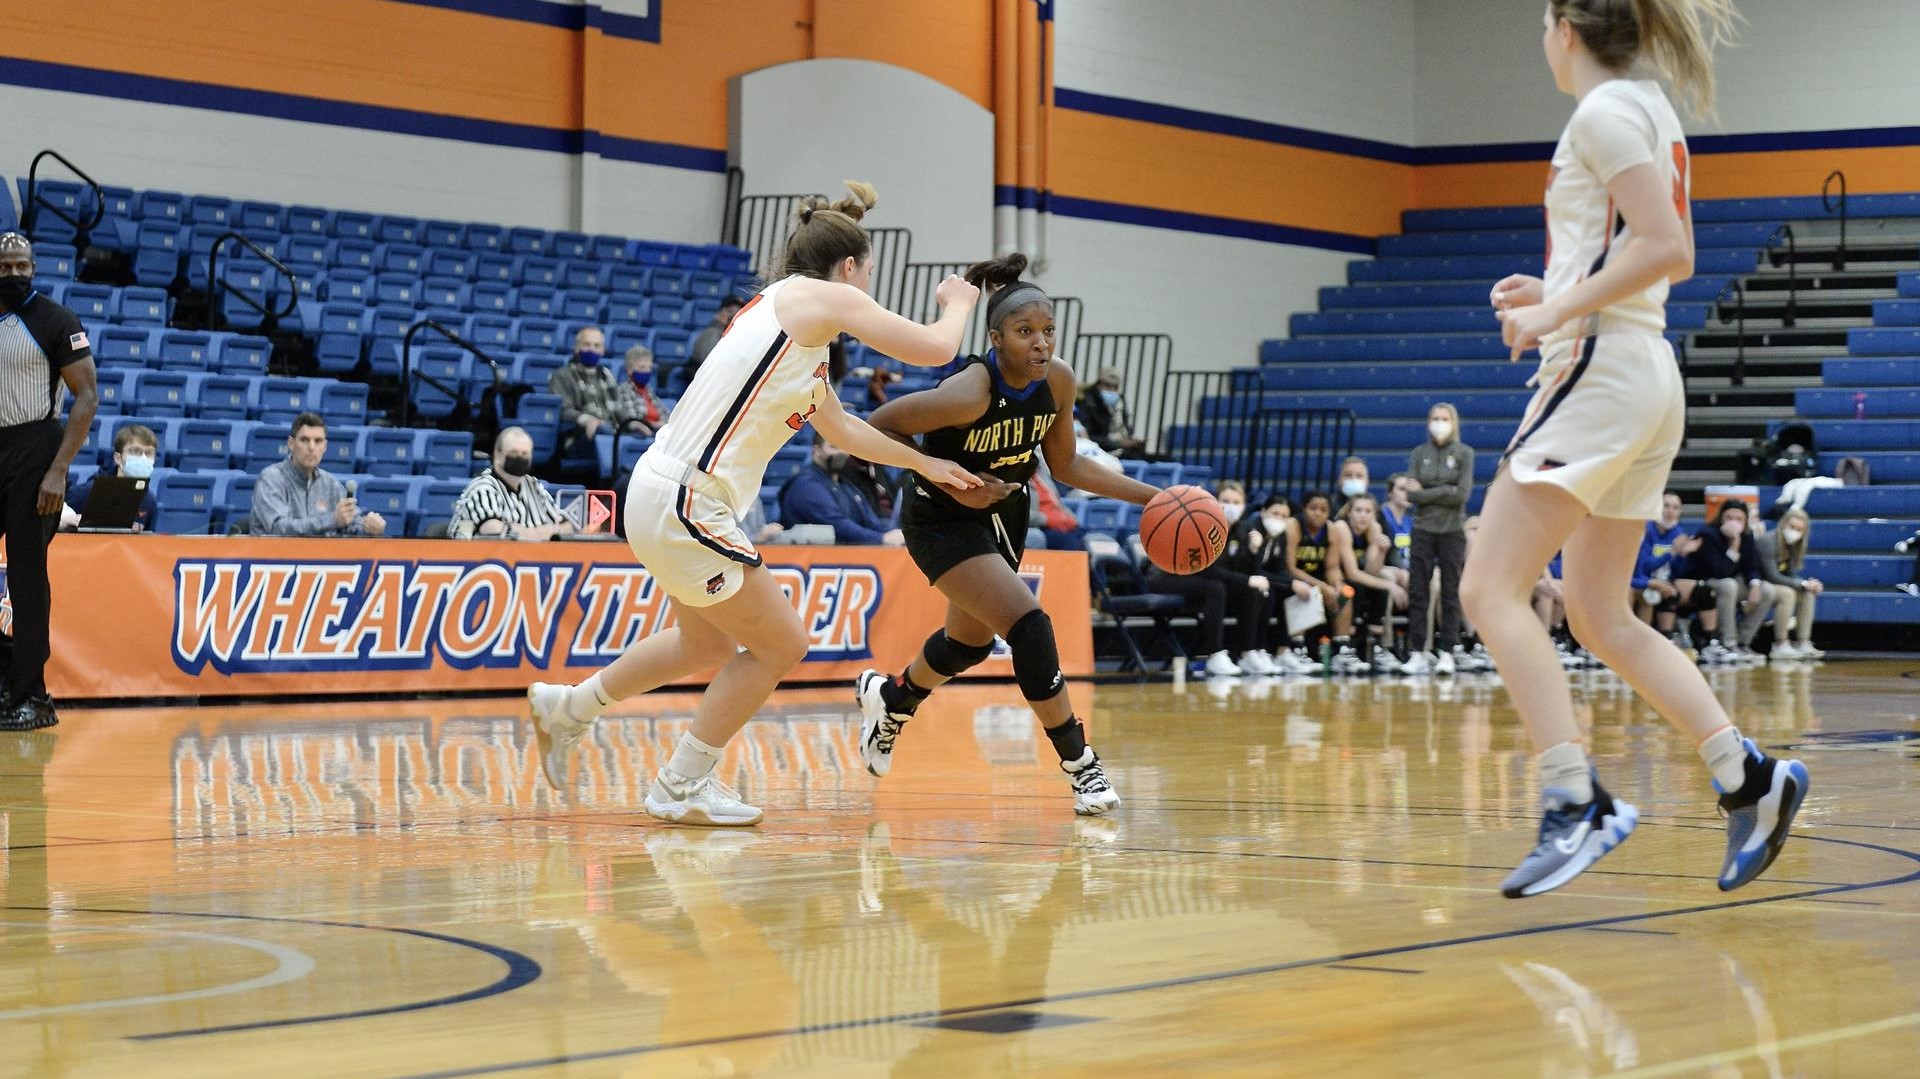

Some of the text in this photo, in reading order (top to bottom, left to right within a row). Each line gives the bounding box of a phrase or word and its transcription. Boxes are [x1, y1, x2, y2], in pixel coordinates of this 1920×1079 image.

[963, 418, 1024, 453] NORTH
[175, 562, 879, 664] WHEATON THER
